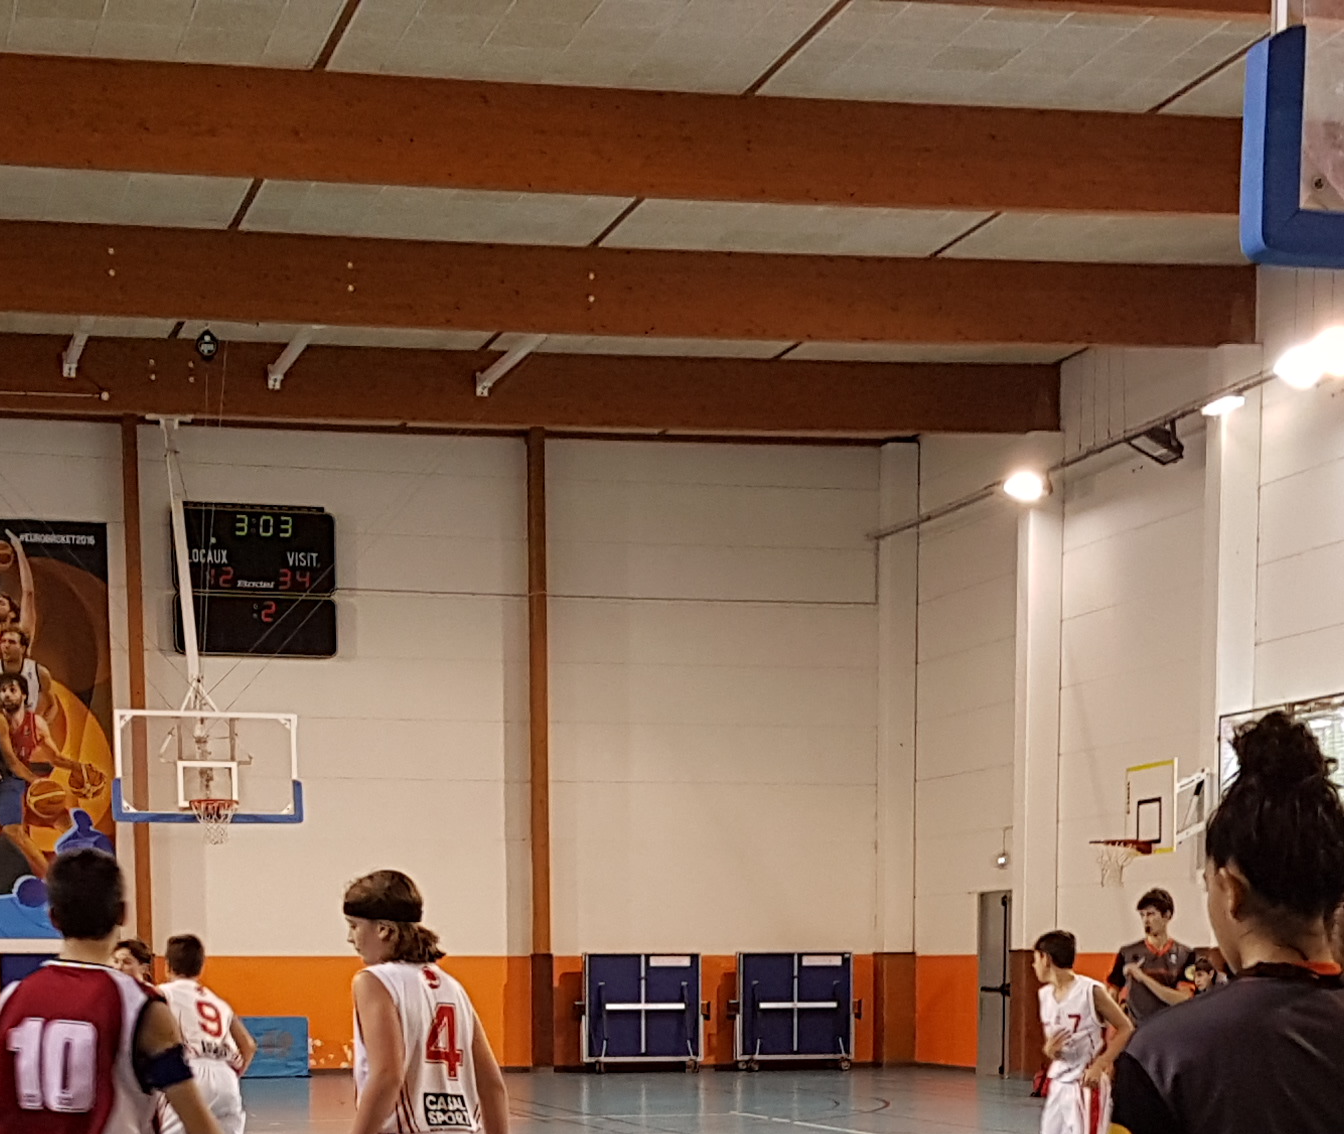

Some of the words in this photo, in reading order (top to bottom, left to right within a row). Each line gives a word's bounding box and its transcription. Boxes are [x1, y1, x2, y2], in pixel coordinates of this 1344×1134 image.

[278, 568, 312, 590] 34
[196, 1000, 223, 1039] 9
[1067, 1013, 1082, 1034] 7
[424, 1002, 464, 1081] 4
[6, 1016, 99, 1113] 10
[427, 1110, 471, 1126] SPORT
